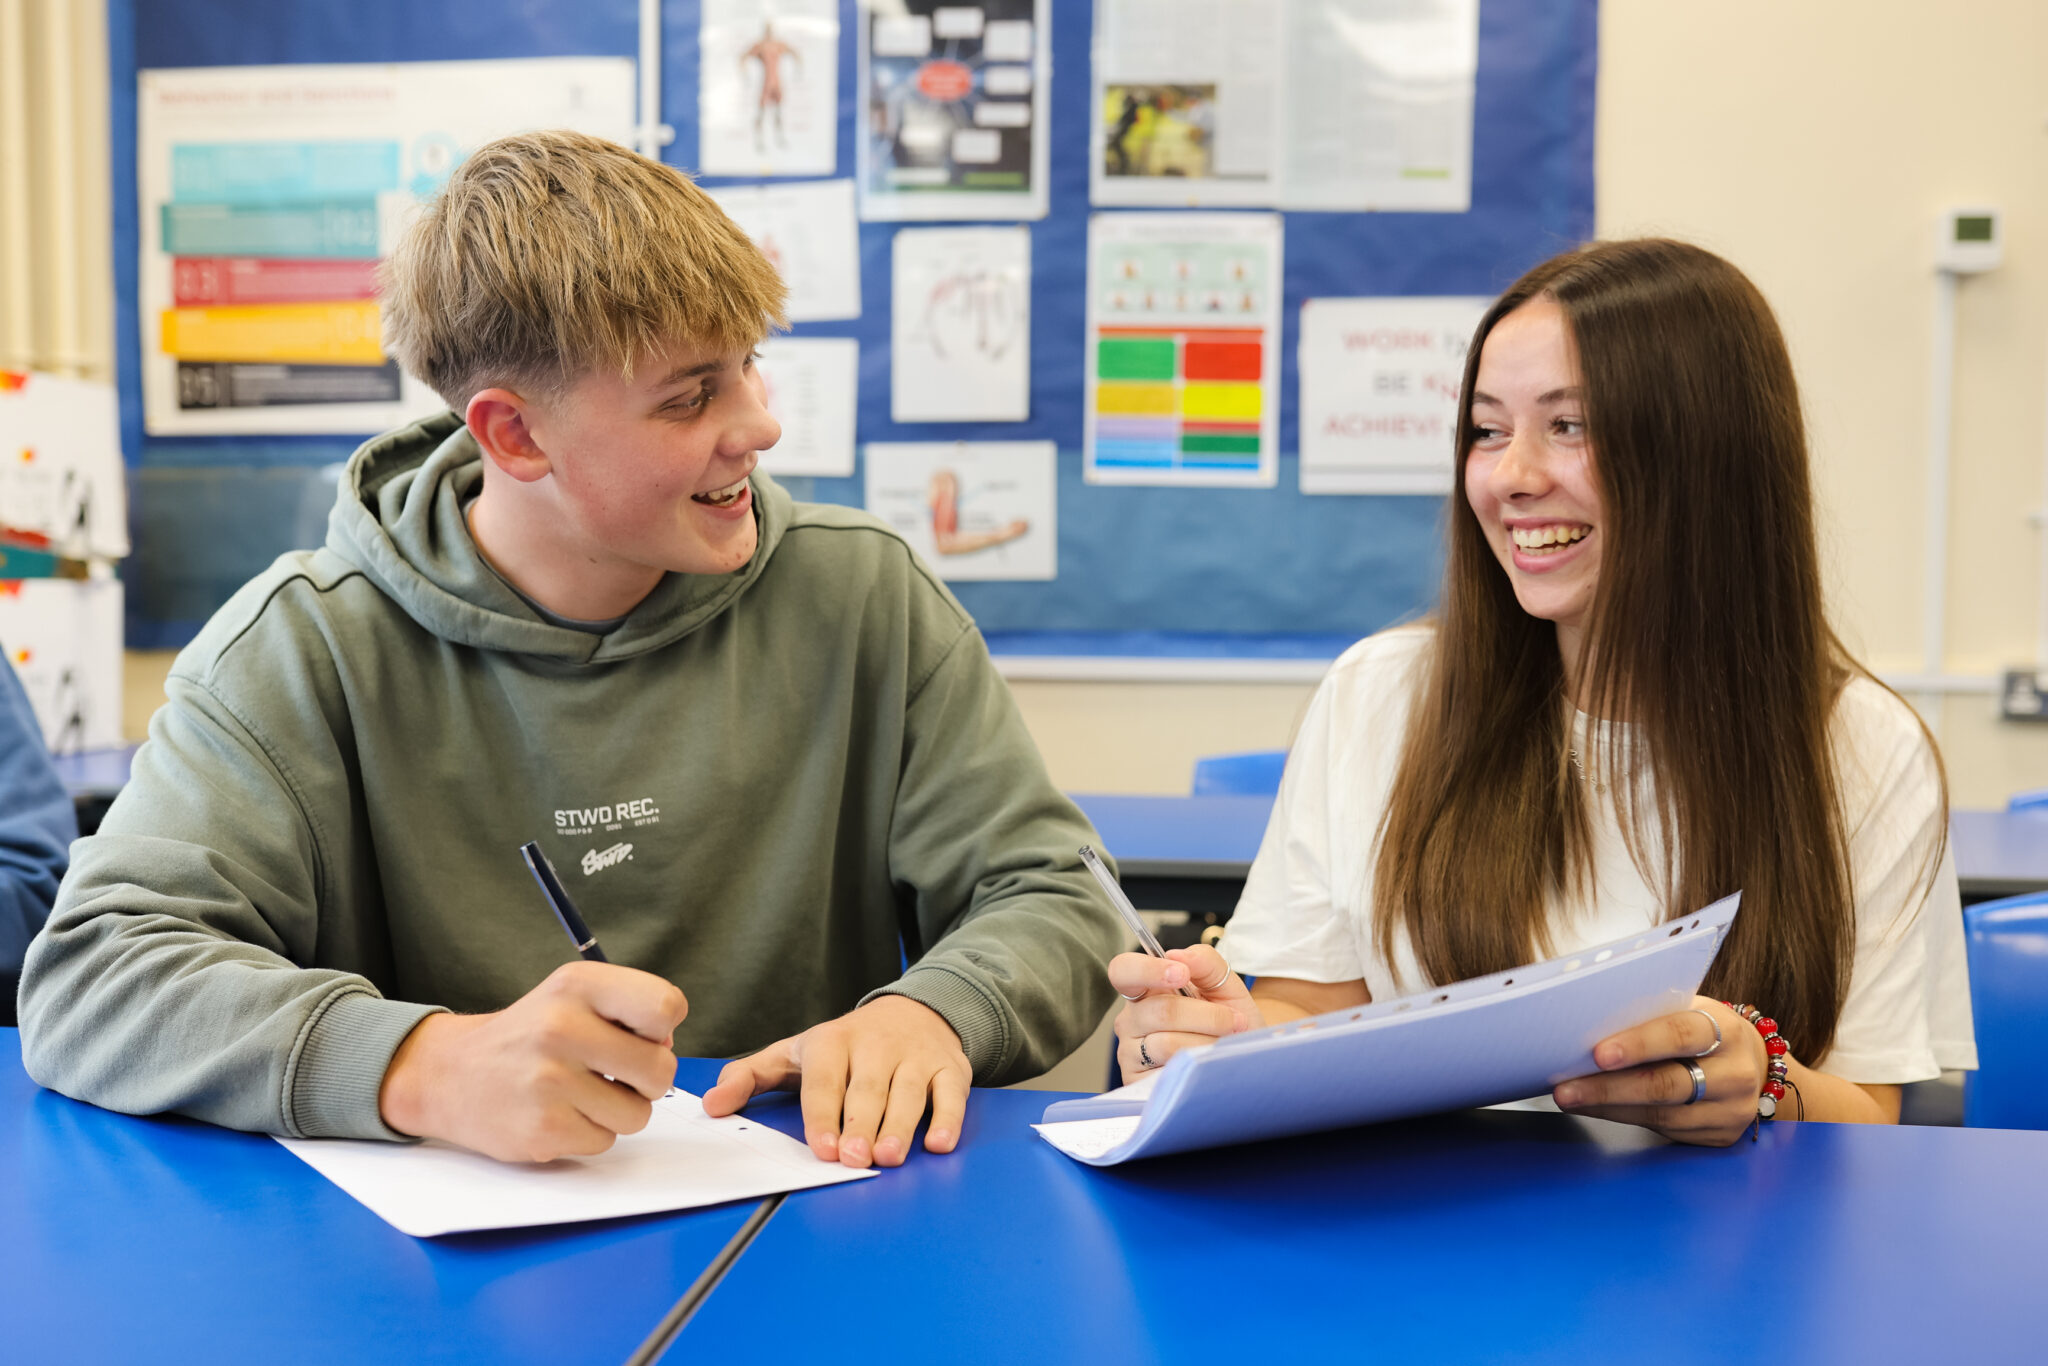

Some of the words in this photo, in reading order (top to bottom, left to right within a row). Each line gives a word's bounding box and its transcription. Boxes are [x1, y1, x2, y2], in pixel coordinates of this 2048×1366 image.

[1342, 329, 1434, 352] WORK
[1373, 370, 1412, 396] BE
[554, 806, 613, 827] STWD
[615, 797, 660, 821] REC.
